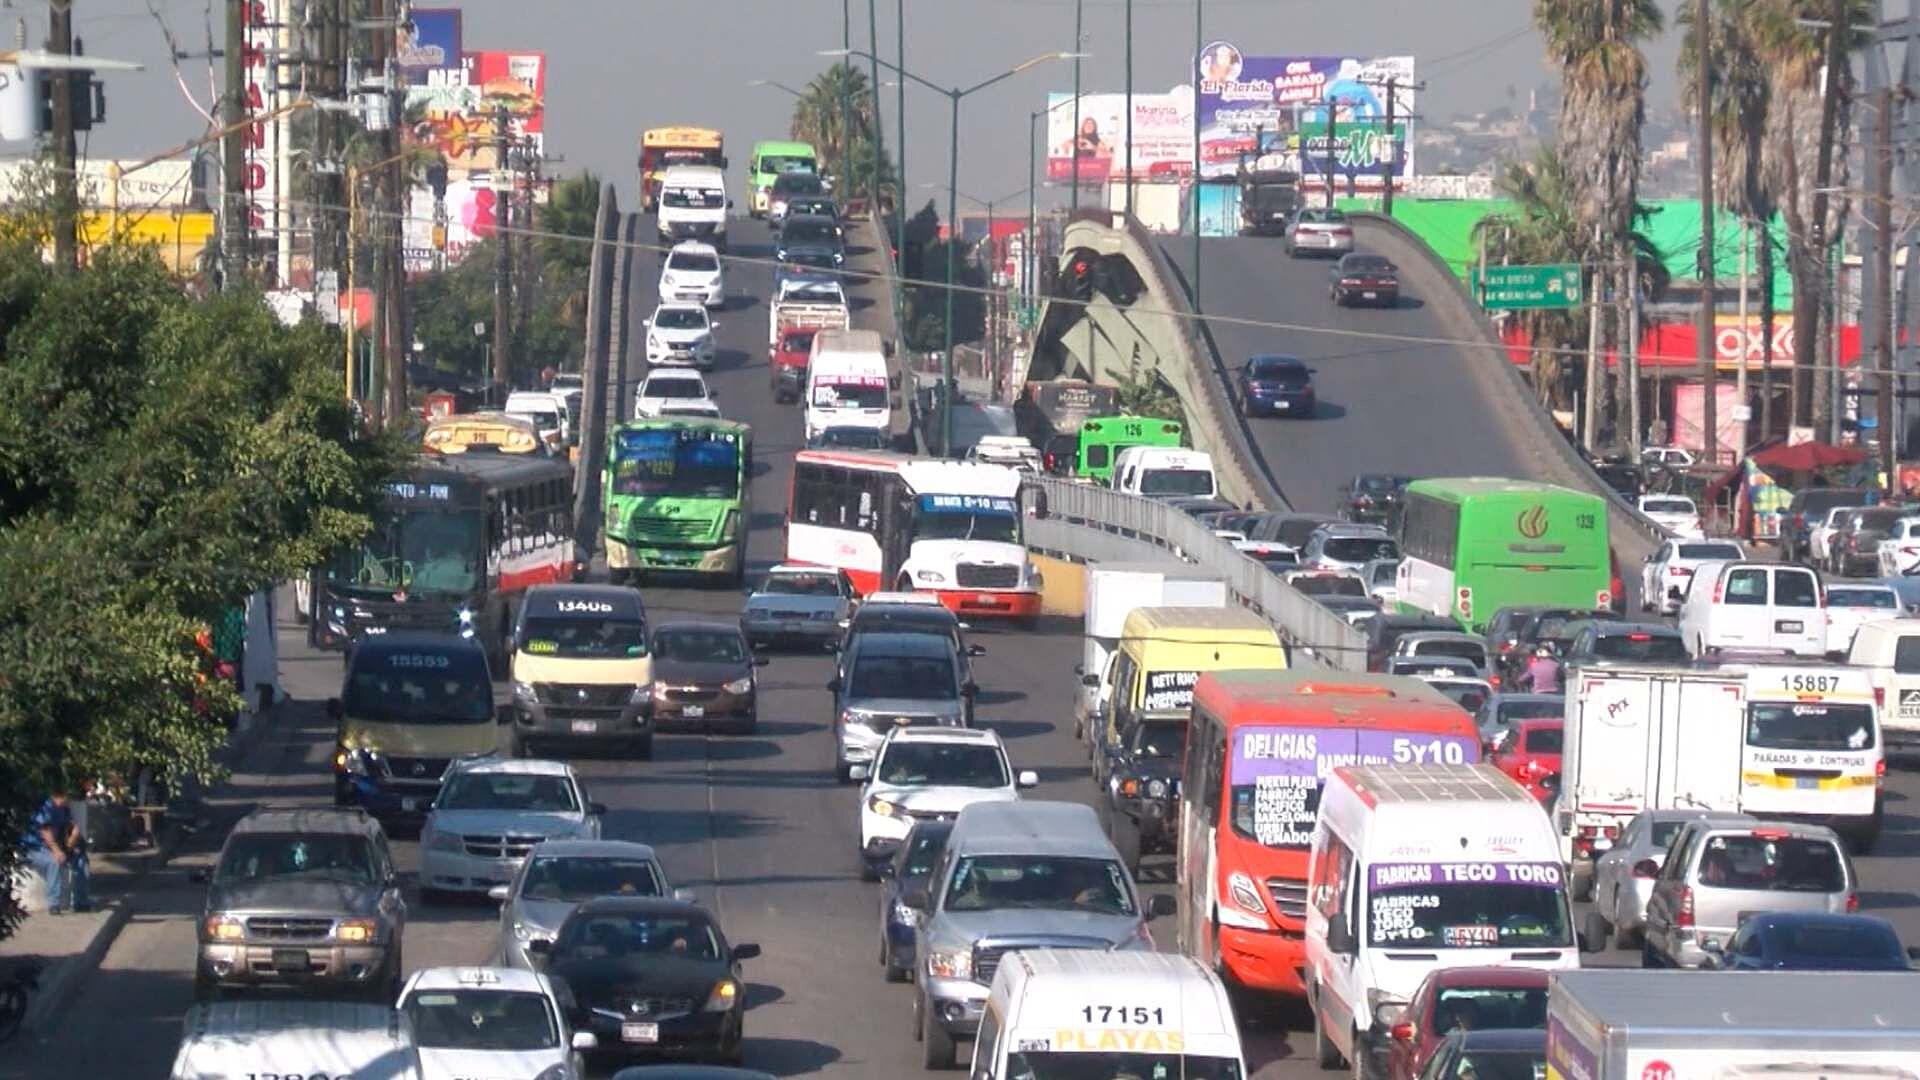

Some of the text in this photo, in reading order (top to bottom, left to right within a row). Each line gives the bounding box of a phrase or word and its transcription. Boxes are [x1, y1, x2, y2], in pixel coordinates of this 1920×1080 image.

[1125, 424, 1142, 437] 126
[1782, 674, 1840, 693] 15887
[1243, 734, 1316, 760] DELICIAS
[1255, 789, 1307, 800] FABRICAS
[1255, 800, 1305, 812] PACIFICO
[1255, 811, 1316, 823] BARCELONA
[1376, 864, 1559, 885] FABRICAS TECO TORO
[1373, 896, 1440, 909] FABRICAS
[1373, 908, 1414, 919] TECO
[1373, 919, 1414, 930] TORO
[1082, 1004, 1164, 1025] 17151
[1055, 1027, 1186, 1052] PLAYAS
